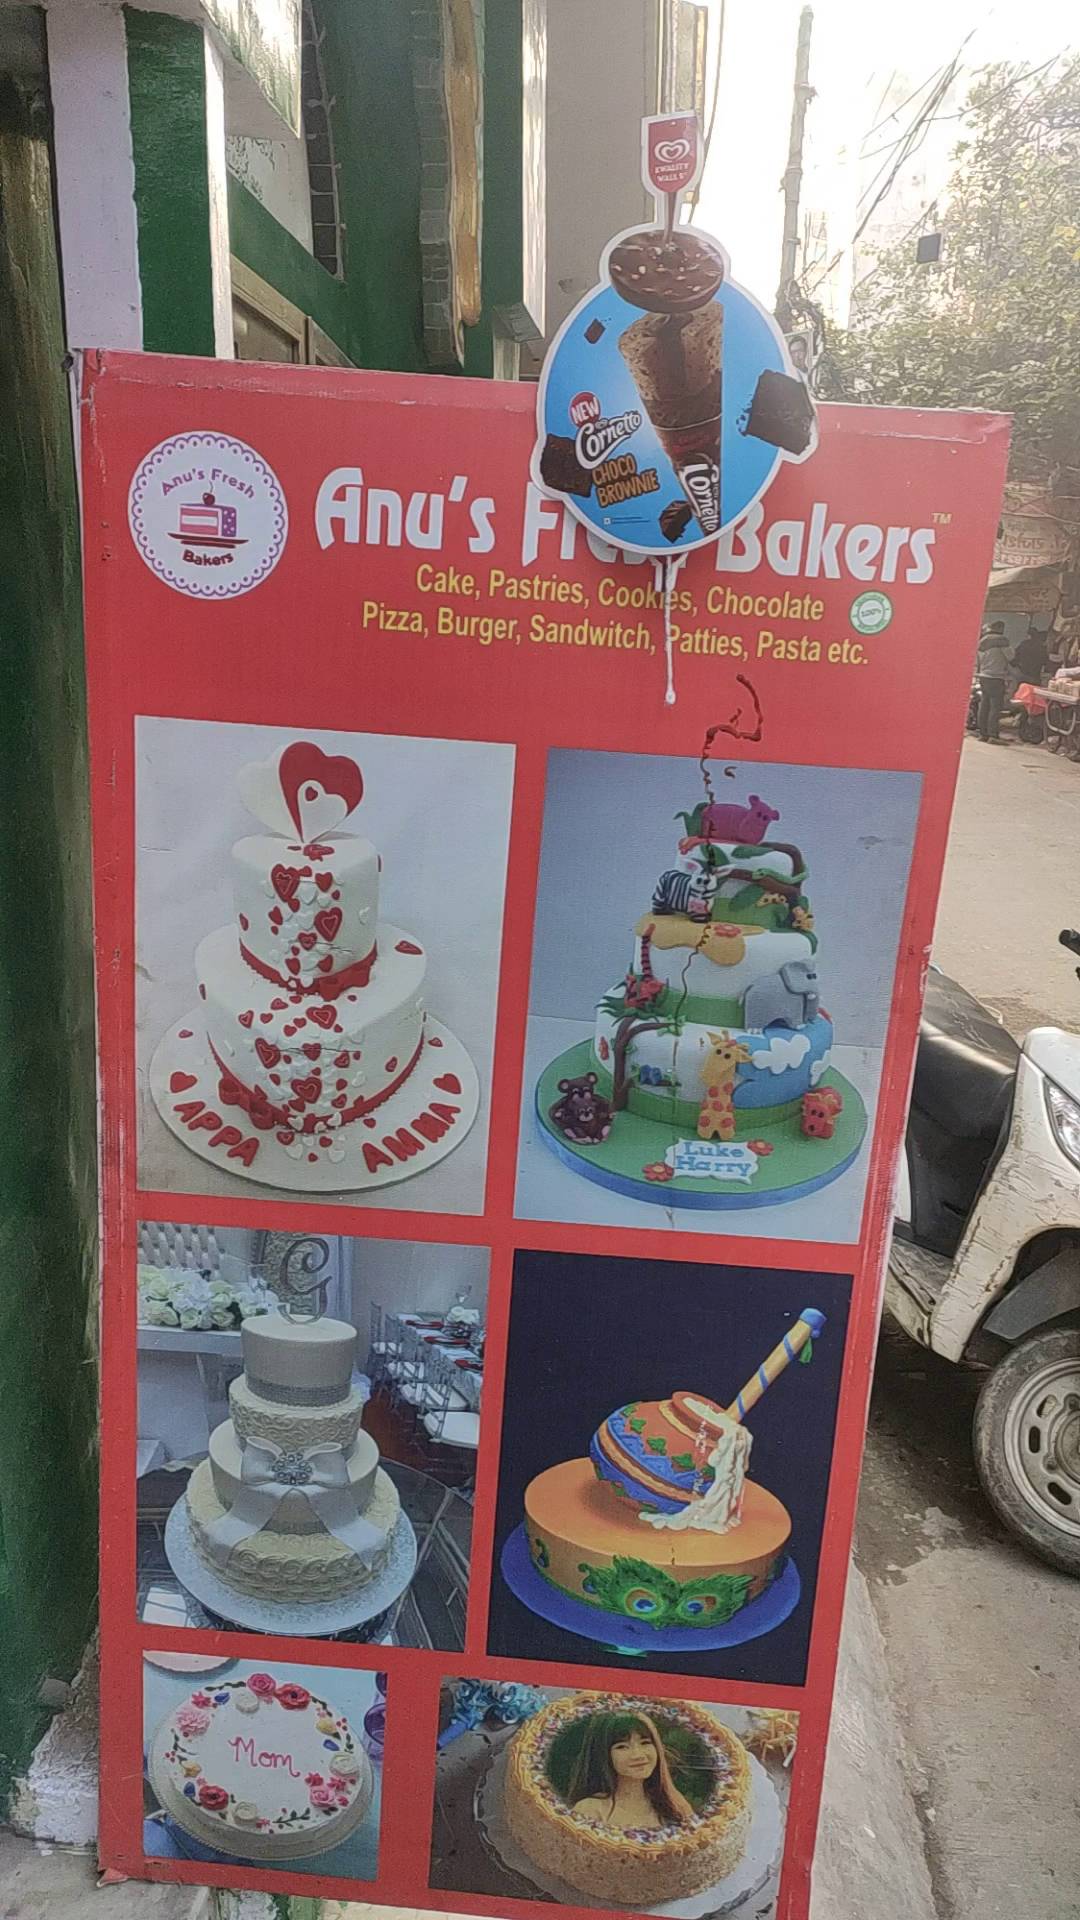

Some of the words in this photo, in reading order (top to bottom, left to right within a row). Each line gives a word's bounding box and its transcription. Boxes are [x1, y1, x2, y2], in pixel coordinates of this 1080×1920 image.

[571, 396, 600, 425] NEW
[575, 410, 642, 470] Cornetto
[161, 468, 205, 497] Anu's
[211, 468, 255, 499] Fresh
[591, 454, 636, 486] CHOCO
[596, 470, 660, 507] BROWNIE
[314, 466, 496, 553] Anu's
[715, 500, 936, 584] Bakers
[182, 549, 234, 567] Bakers
[416, 563, 481, 599] Cake,
[489, 569, 590, 609] Pastries,
[706, 585, 825, 620] Chocolate
[362, 601, 430, 638] Pizza,
[437, 607, 521, 645] Burger,
[529, 614, 656, 655] Sandwitch,
[668, 623, 749, 662] Patties,
[757, 630, 821, 661] Pasta
[827, 638, 870, 665] etc.
[173, 1100, 260, 1167] APPA
[361, 1102, 461, 1173] AMMA
[683, 1141, 745, 1158] Luke
[674, 1155, 752, 1177] Harry
[227, 1736, 301, 1778] Mom
